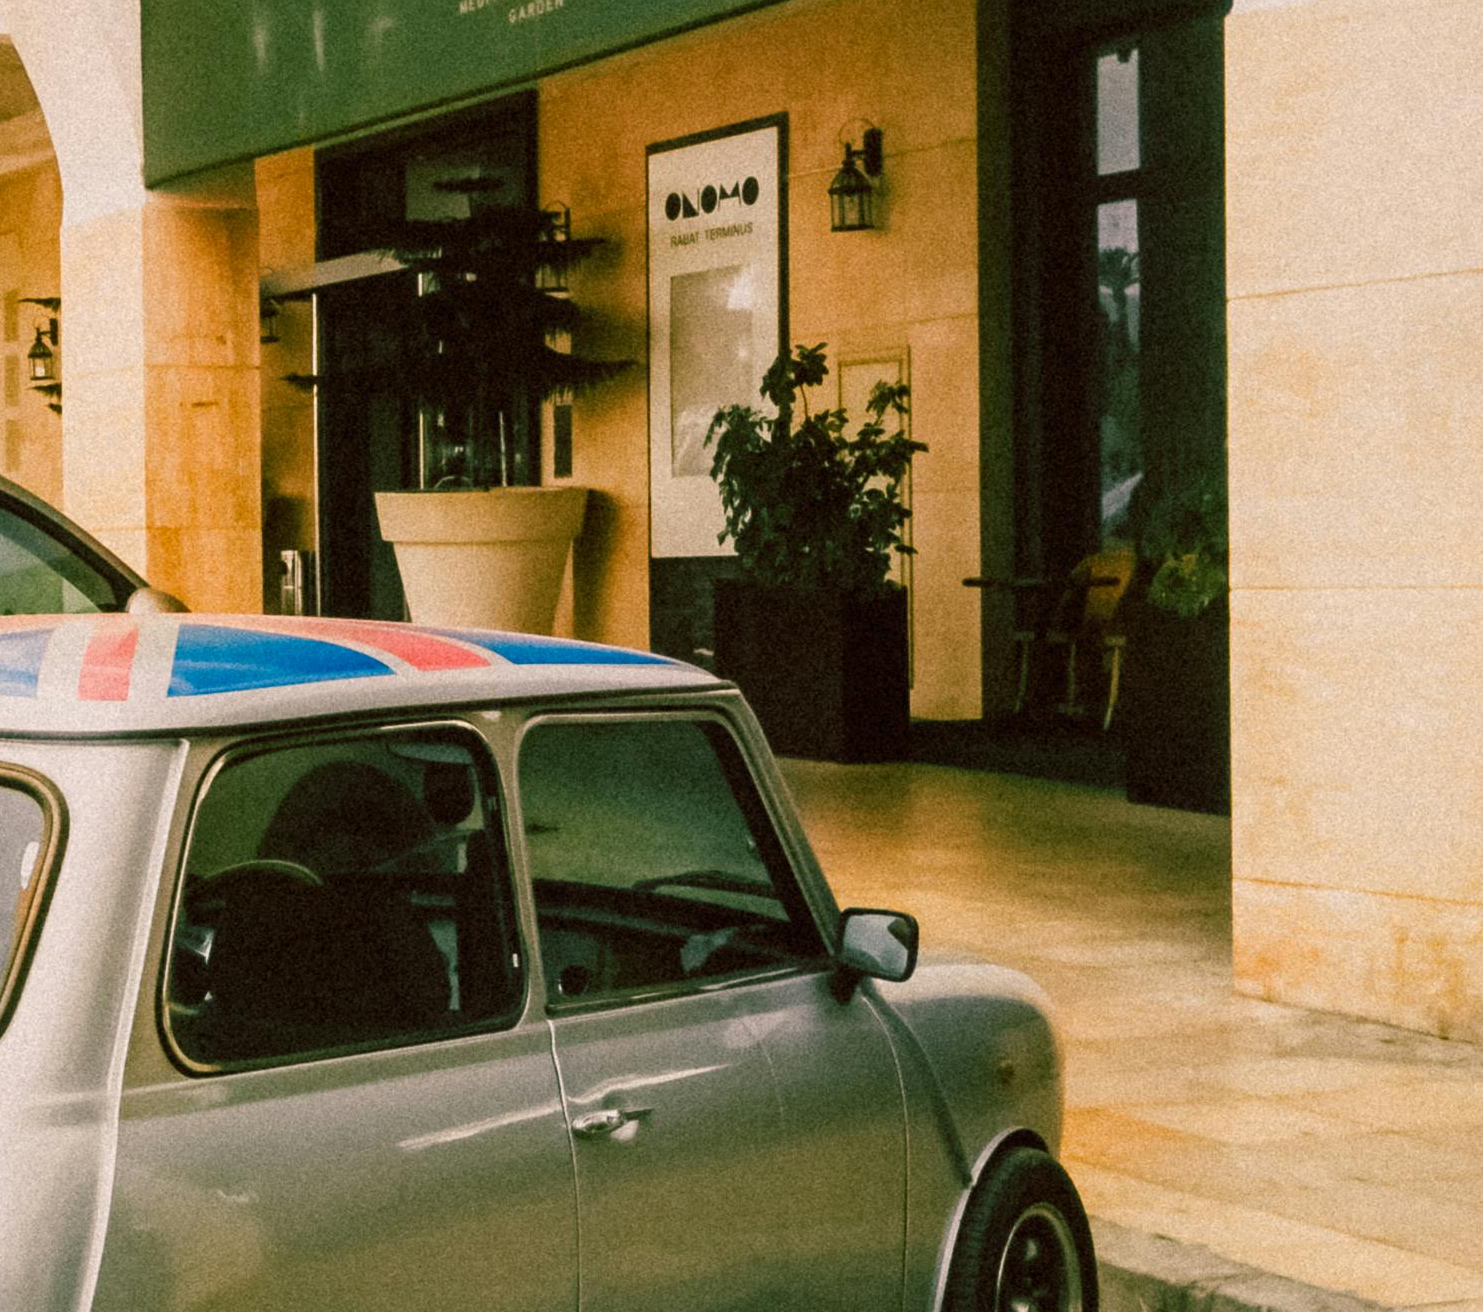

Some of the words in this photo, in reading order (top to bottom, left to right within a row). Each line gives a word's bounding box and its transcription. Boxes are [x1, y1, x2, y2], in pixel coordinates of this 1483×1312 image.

[664, 175, 760, 221] ONOMO
[669, 232, 700, 247] RABAT
[704, 221, 754, 241] TERMINUS
